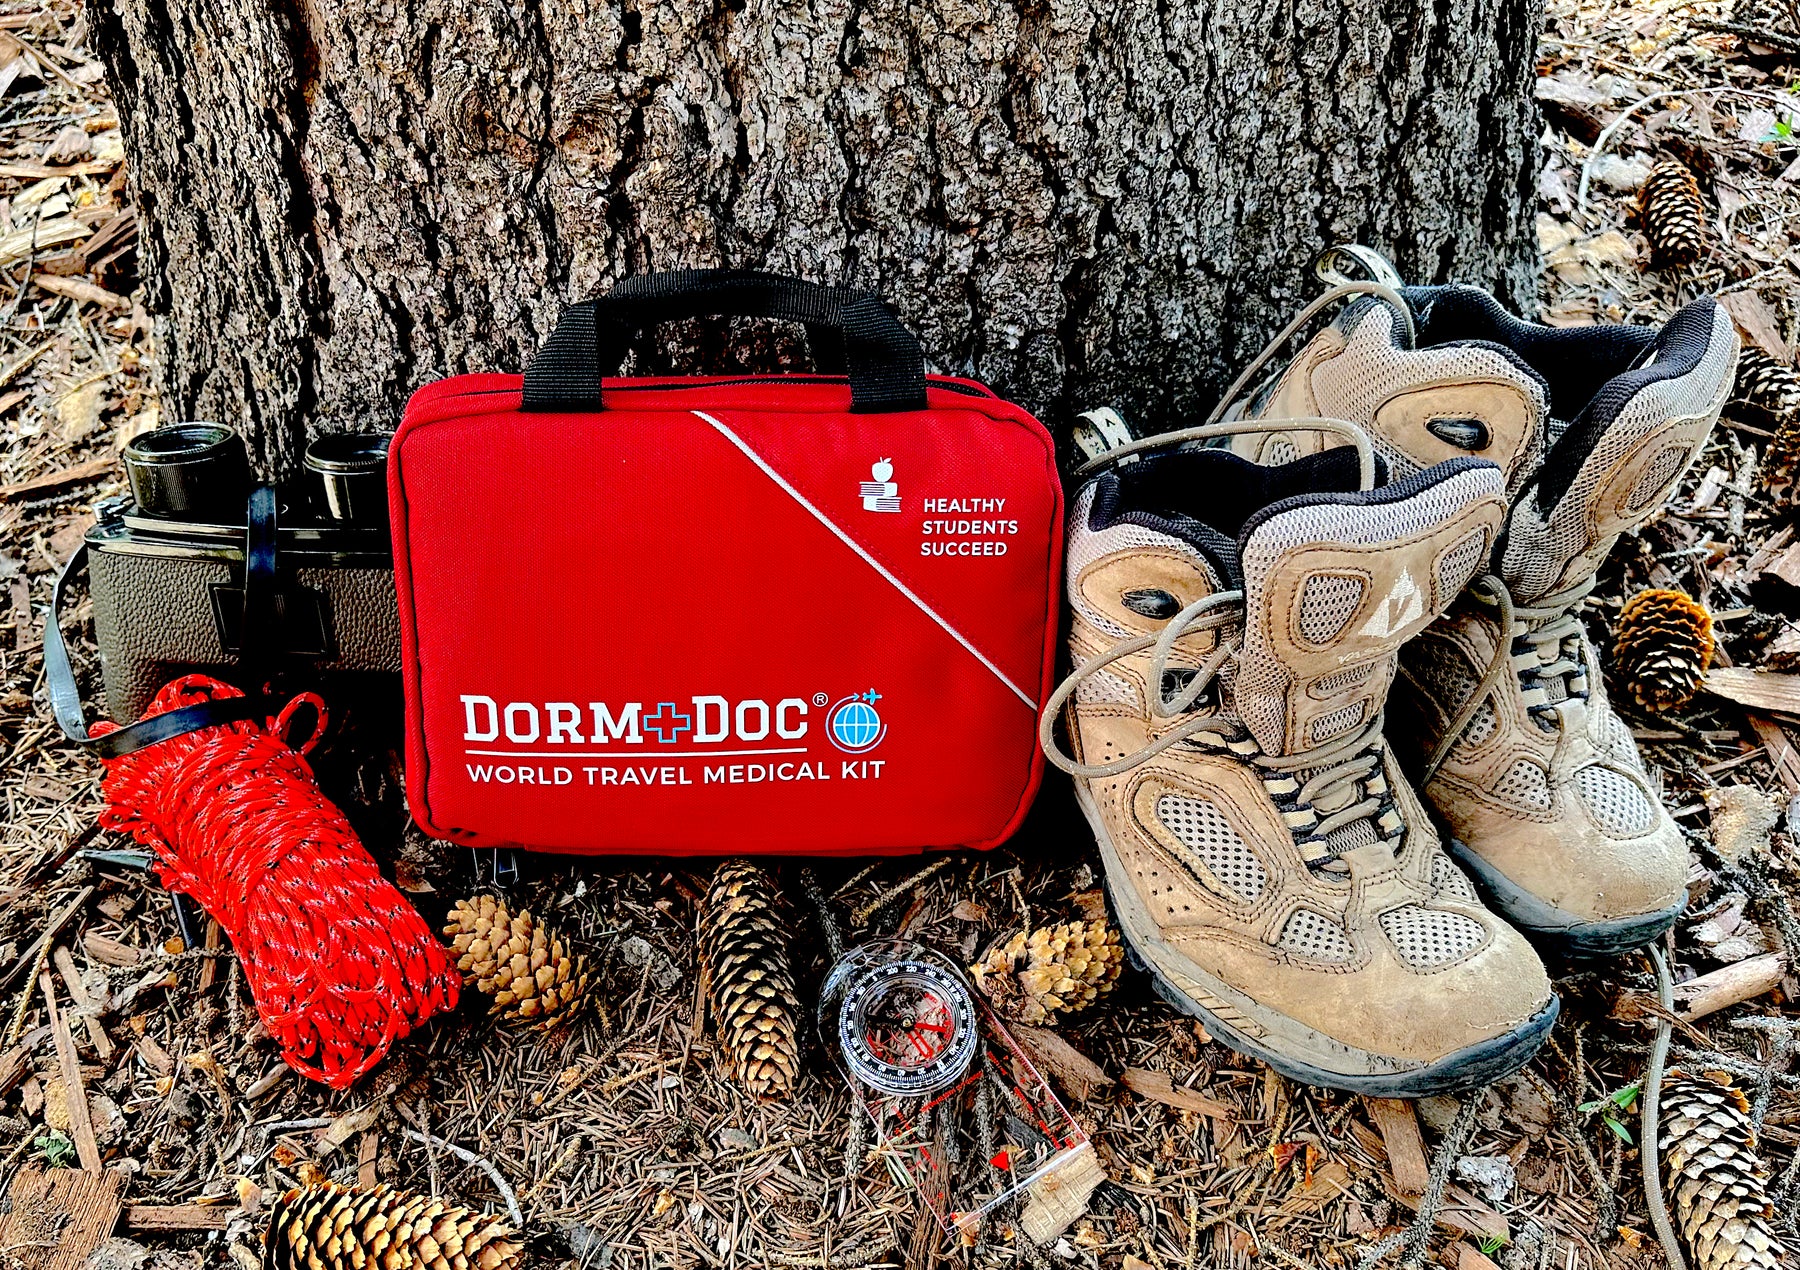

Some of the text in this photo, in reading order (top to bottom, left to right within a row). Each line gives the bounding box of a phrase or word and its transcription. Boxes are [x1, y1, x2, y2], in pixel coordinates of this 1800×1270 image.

[925, 499, 1005, 512] HEALTHY
[923, 520, 1018, 534] STUDENTS
[921, 542, 1007, 555] SUCCEED
[466, 761, 885, 785] WORLD TRAVEL MEDICAL KIT
